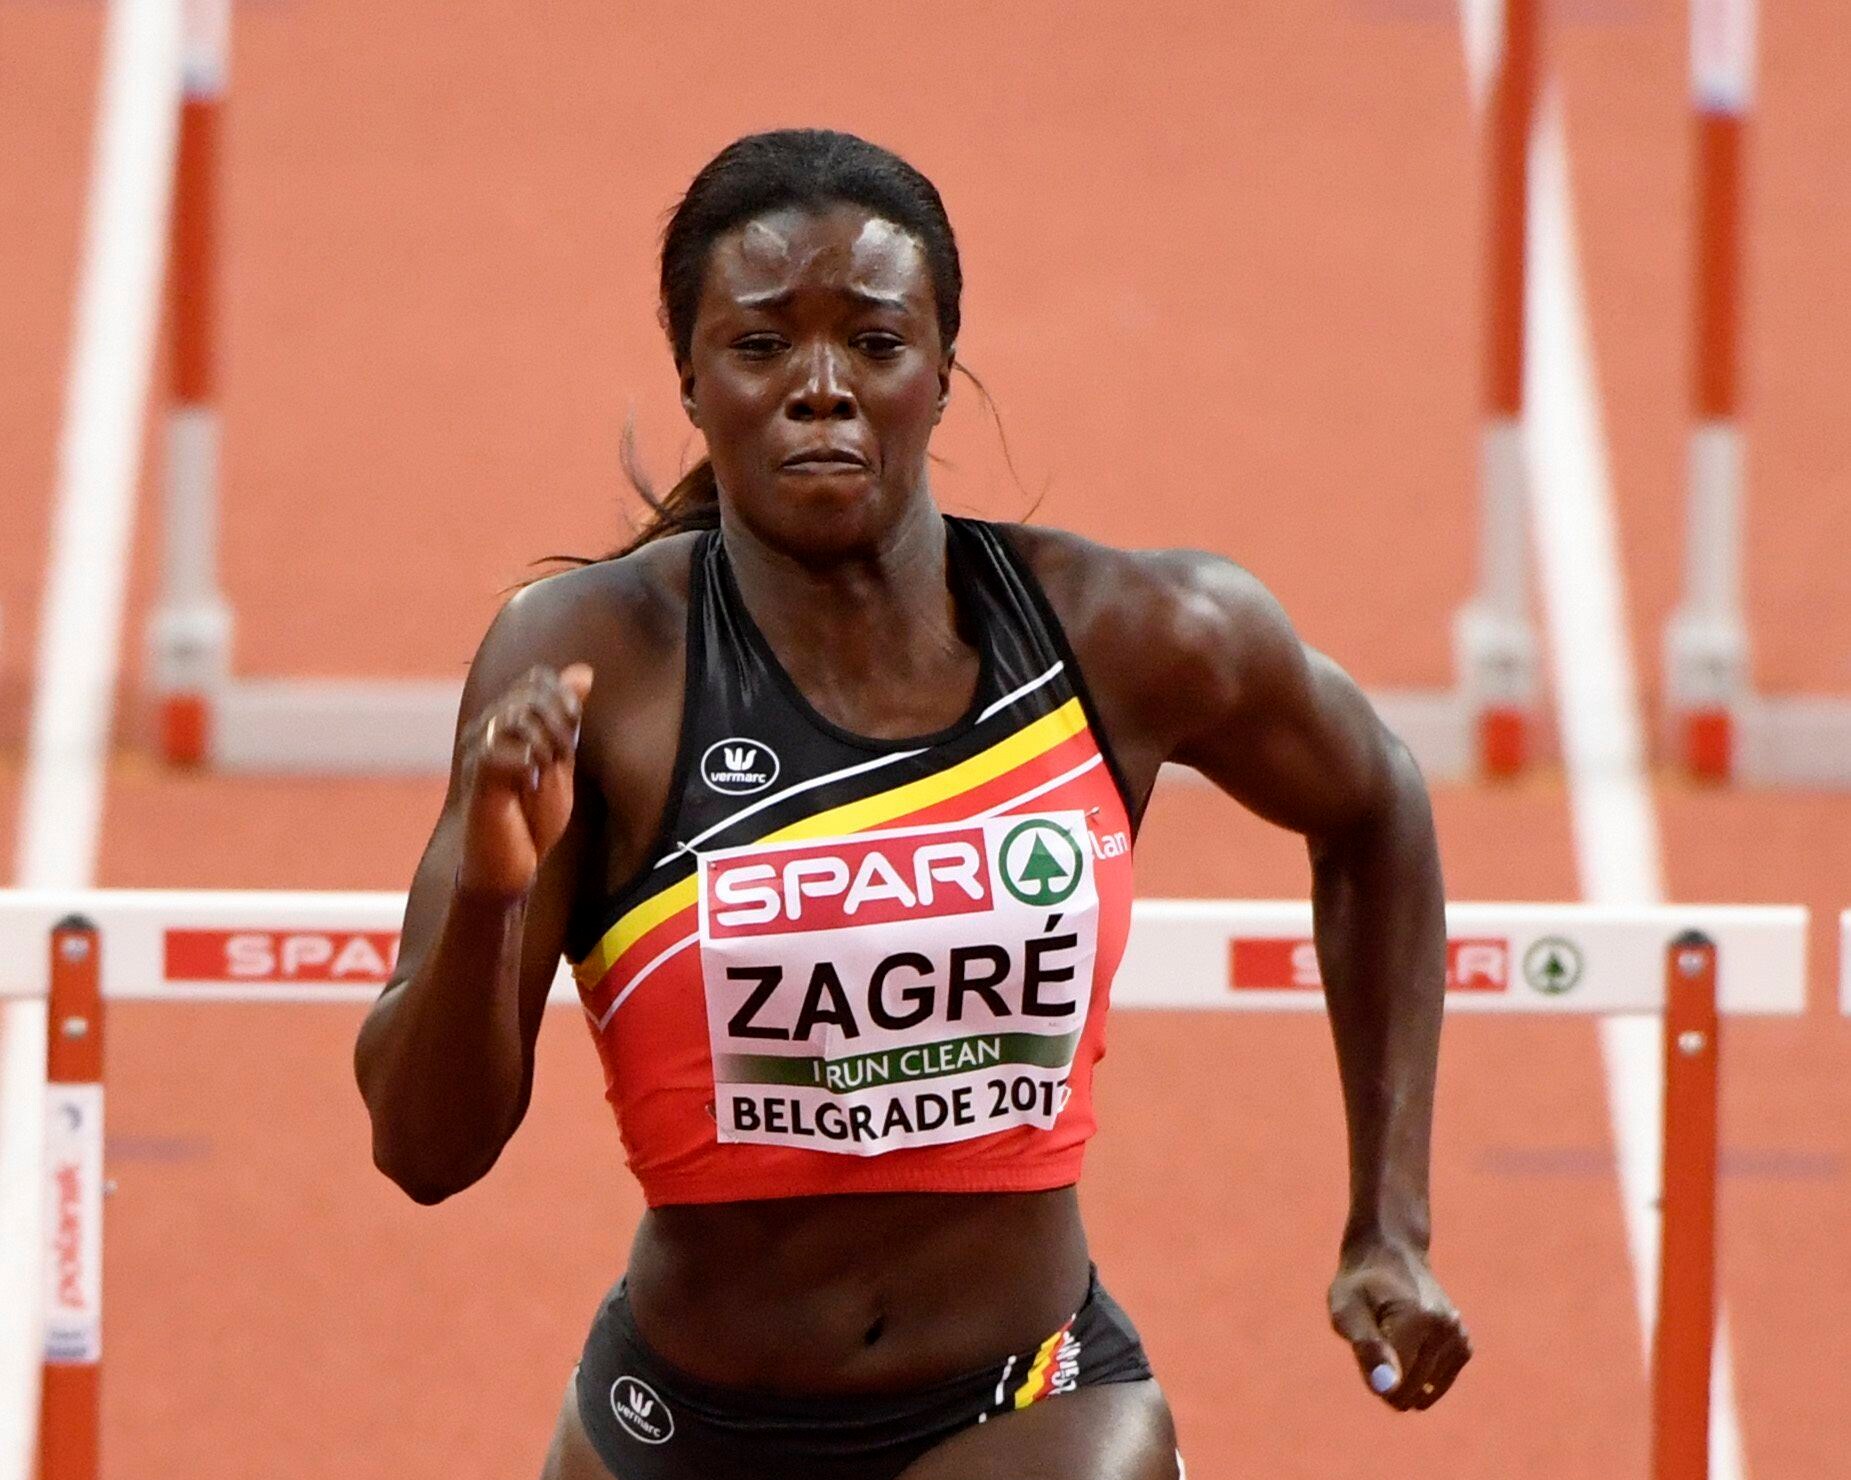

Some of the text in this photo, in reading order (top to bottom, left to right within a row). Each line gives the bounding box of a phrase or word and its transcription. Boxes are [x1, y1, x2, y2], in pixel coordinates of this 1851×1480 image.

[711, 772, 767, 783] vermarc
[716, 842, 985, 926] SPAR
[226, 935, 401, 977] SPA
[725, 914, 1078, 1041] ZAGRÉ
[813, 1038, 1000, 1089] I RUN CLEAN
[732, 1088, 975, 1142] BELGRADE
[617, 1401, 661, 1438] vermarc
